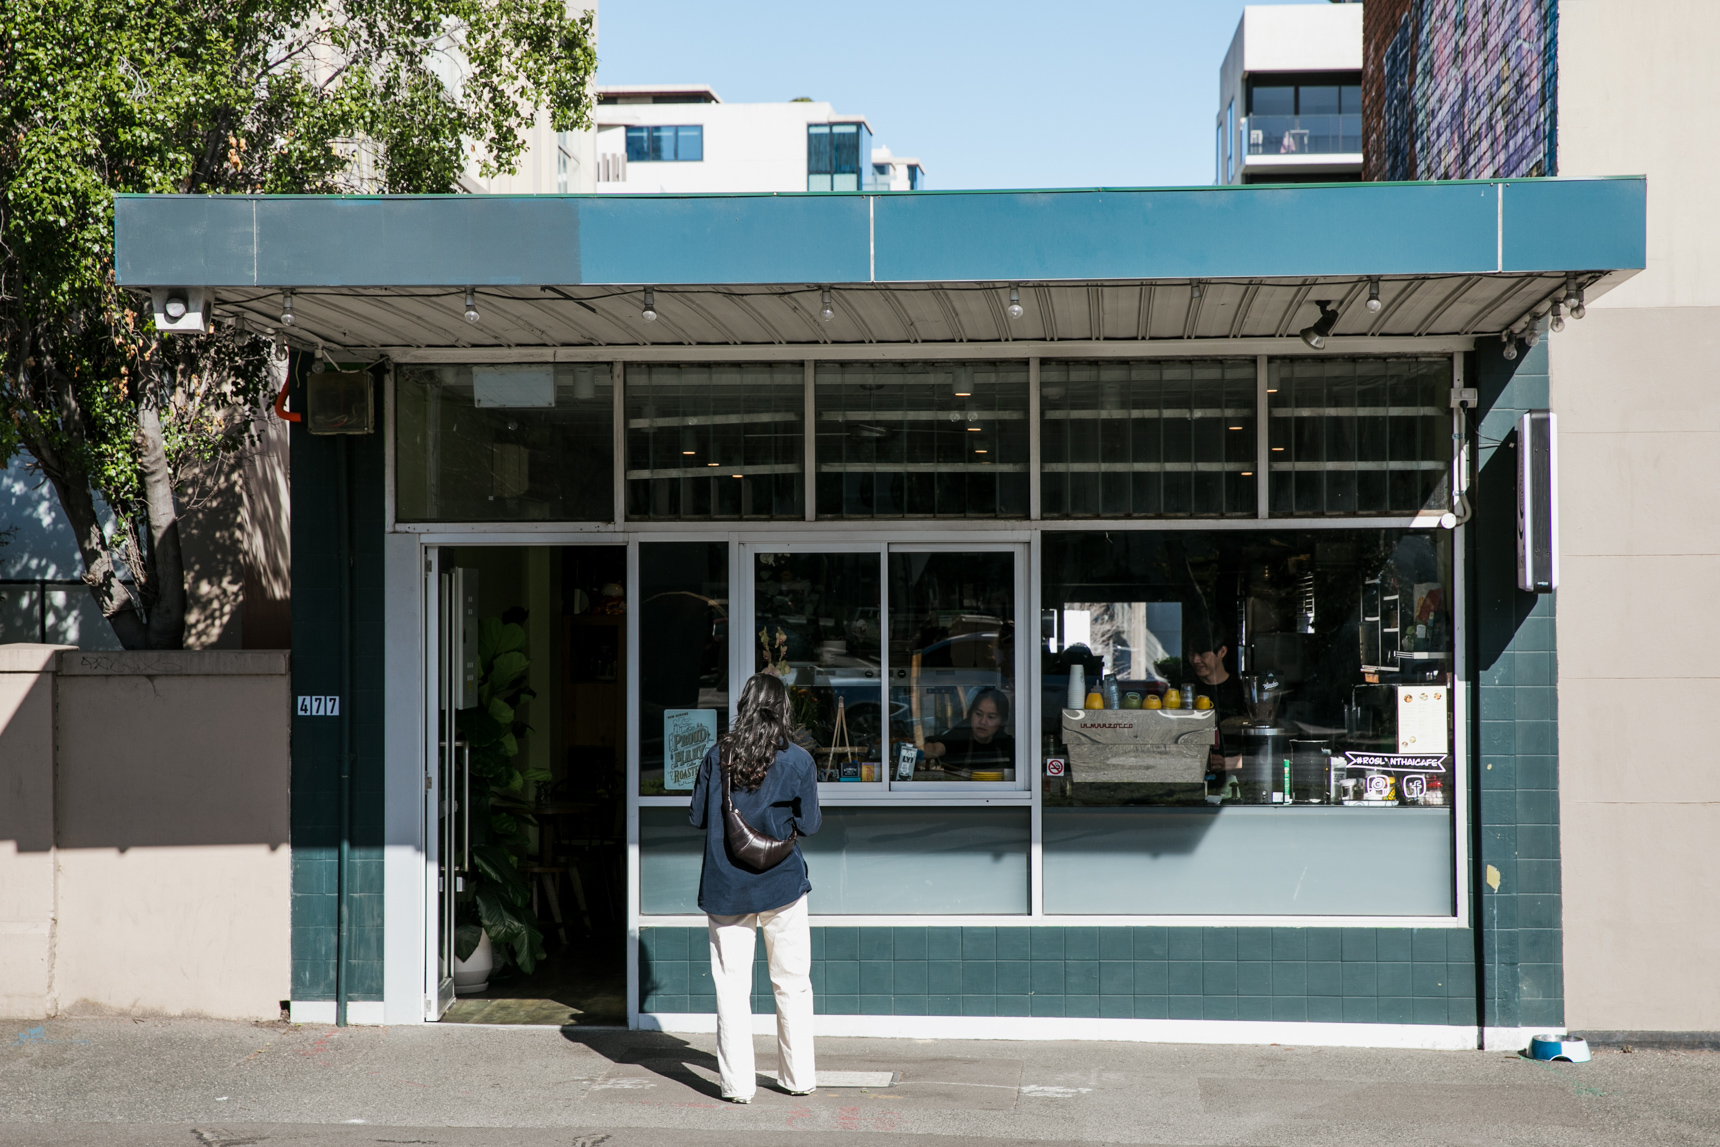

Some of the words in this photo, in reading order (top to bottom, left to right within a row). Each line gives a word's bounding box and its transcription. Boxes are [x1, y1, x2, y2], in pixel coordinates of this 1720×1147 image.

[300, 698, 336, 714] 477
[673, 727, 707, 752] PROUD
[673, 744, 707, 769] MARY
[1355, 756, 1438, 767] #ROSLNTHAICAFE
